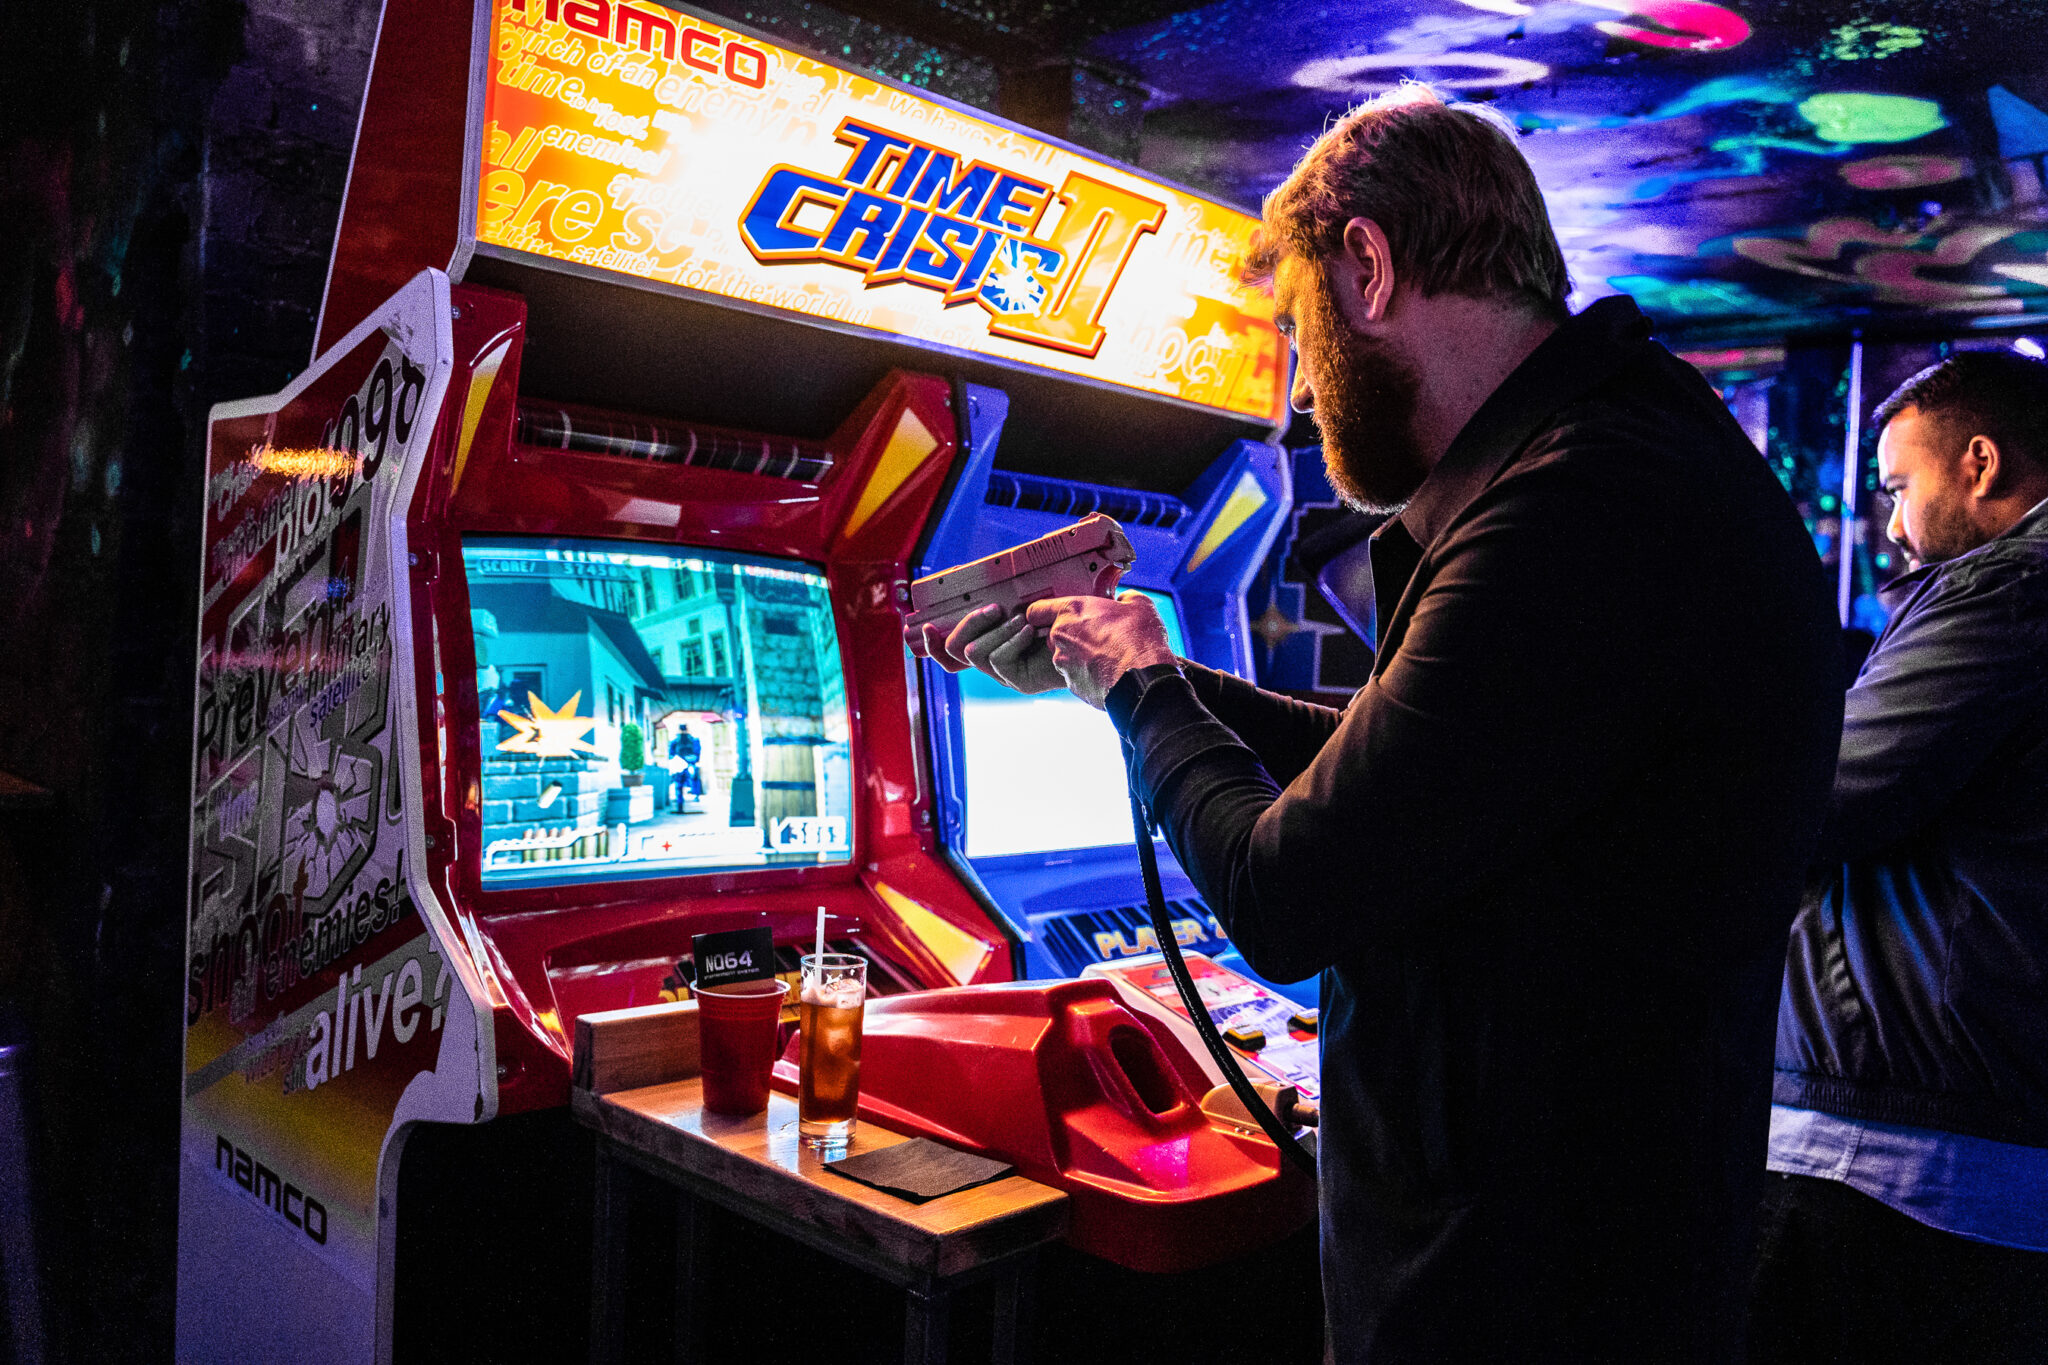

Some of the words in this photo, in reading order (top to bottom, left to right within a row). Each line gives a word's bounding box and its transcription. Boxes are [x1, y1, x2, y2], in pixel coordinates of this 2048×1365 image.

[586, 51, 626, 76] of
[654, 75, 781, 136] enemy
[834, 116, 1054, 234] TIME
[672, 261, 720, 290] for
[720, 268, 766, 299] the
[766, 281, 845, 317] world
[739, 163, 1064, 318] CRISIS
[263, 861, 402, 1001] enemies!
[216, 1134, 328, 1246] namco
